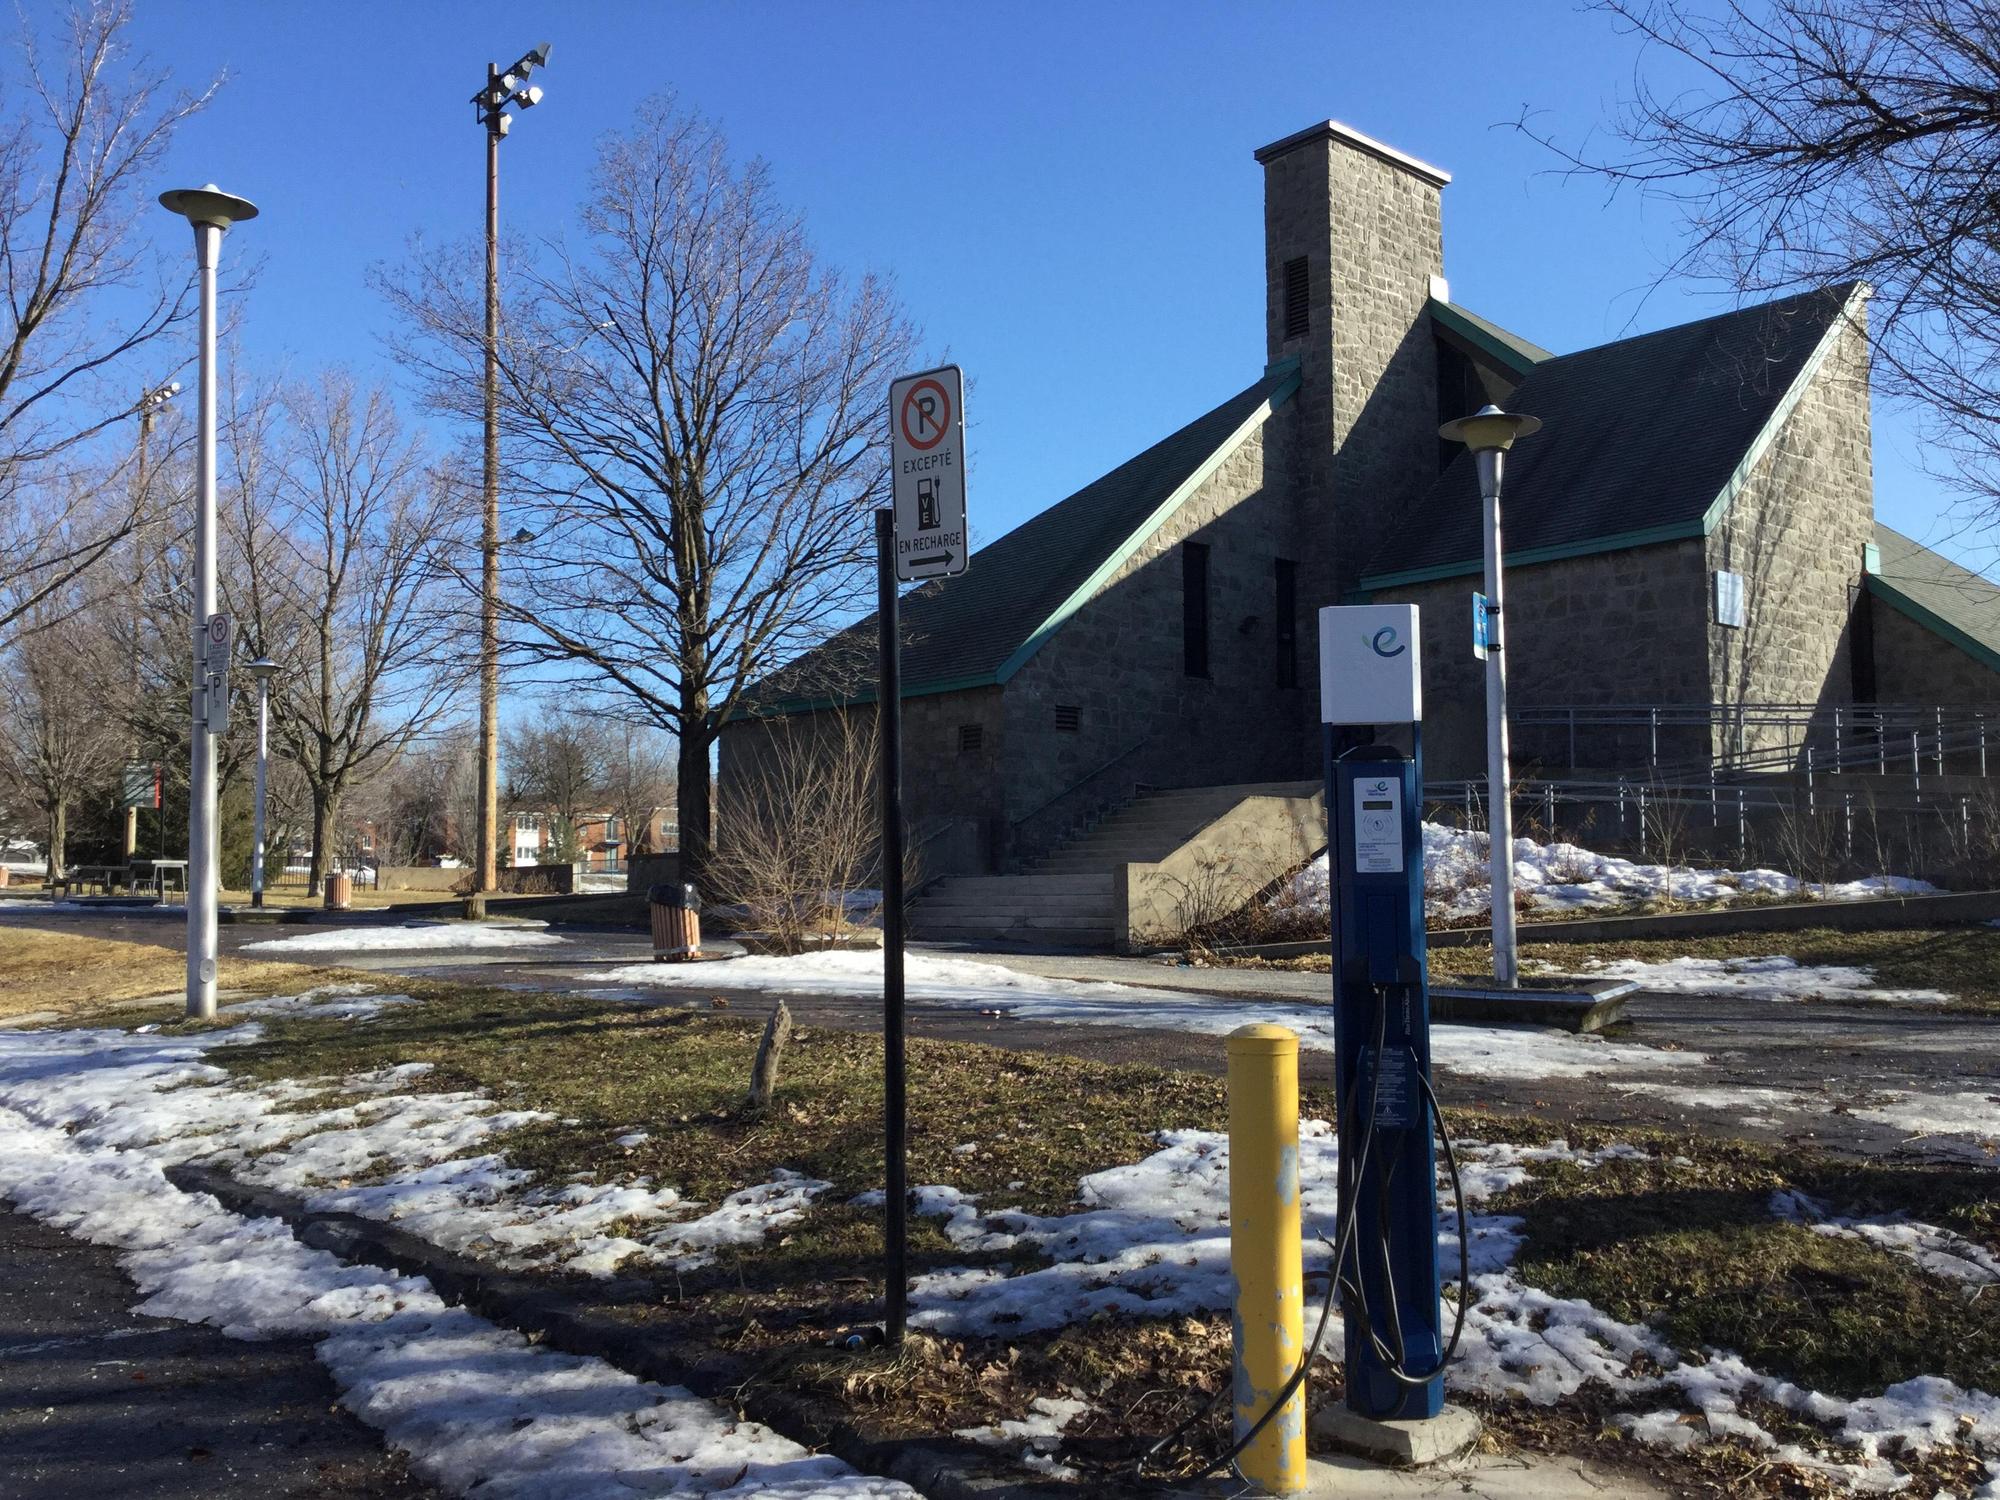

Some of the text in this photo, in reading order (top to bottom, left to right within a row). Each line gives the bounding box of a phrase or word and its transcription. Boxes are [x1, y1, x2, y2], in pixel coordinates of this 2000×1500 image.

[918, 396, 936, 434] P
[903, 448, 953, 474] EXCEPTÉ
[899, 532, 961, 554] EN RECHARGE
[213, 676, 221, 698] P
